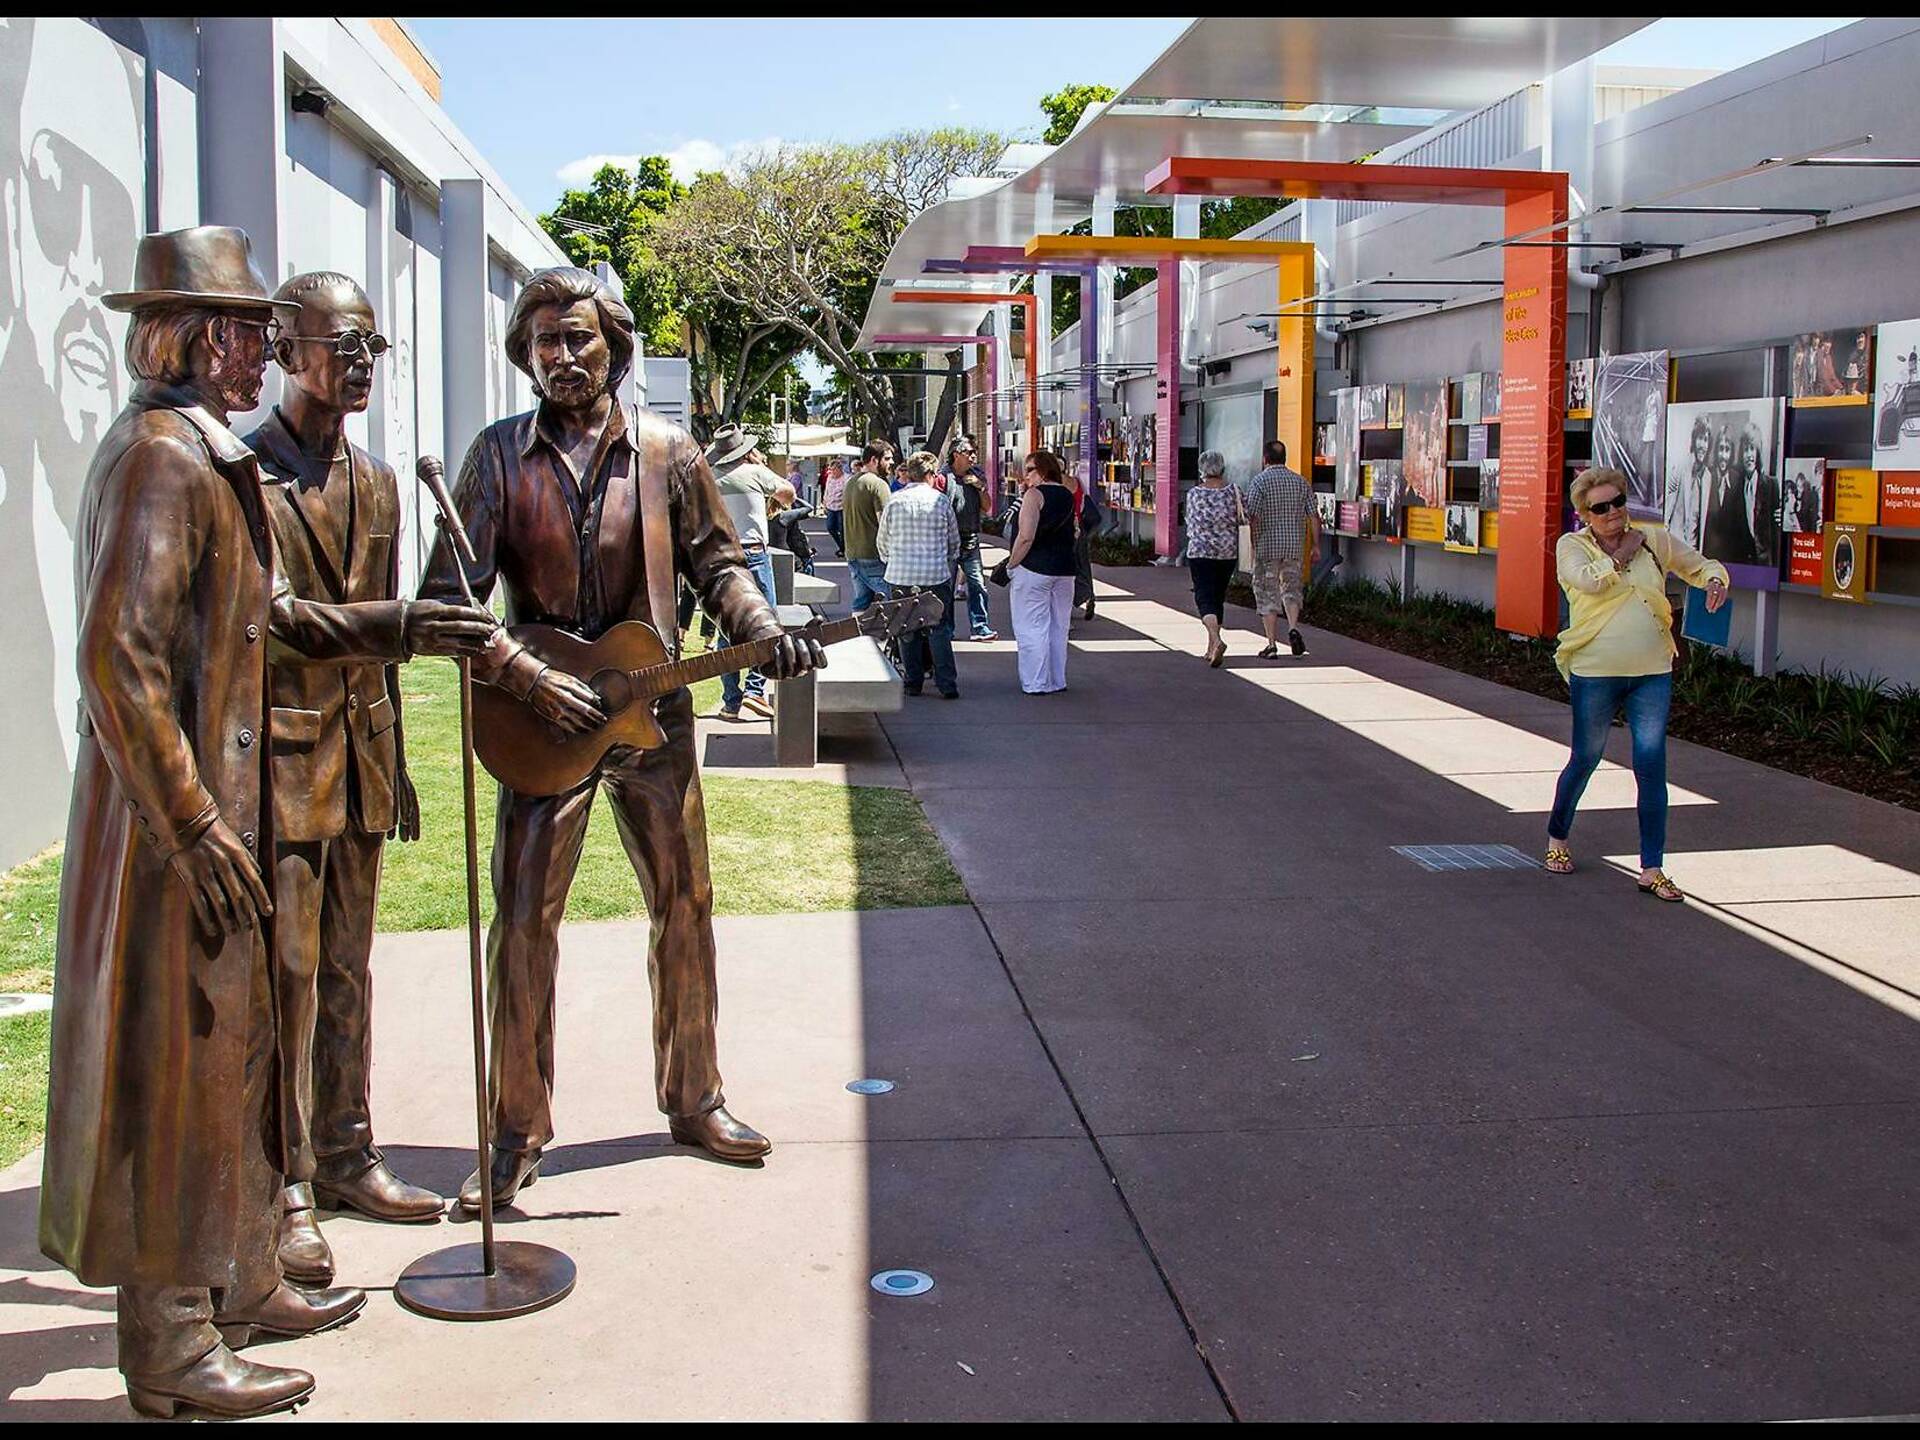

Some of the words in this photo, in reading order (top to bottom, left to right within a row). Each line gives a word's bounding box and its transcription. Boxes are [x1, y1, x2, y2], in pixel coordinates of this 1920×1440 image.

[1539, 208, 1565, 556] AMERICANISATION
[1886, 483, 1900, 495] This
[1901, 486, 1914, 495] one
[1793, 538, 1803, 546] You
